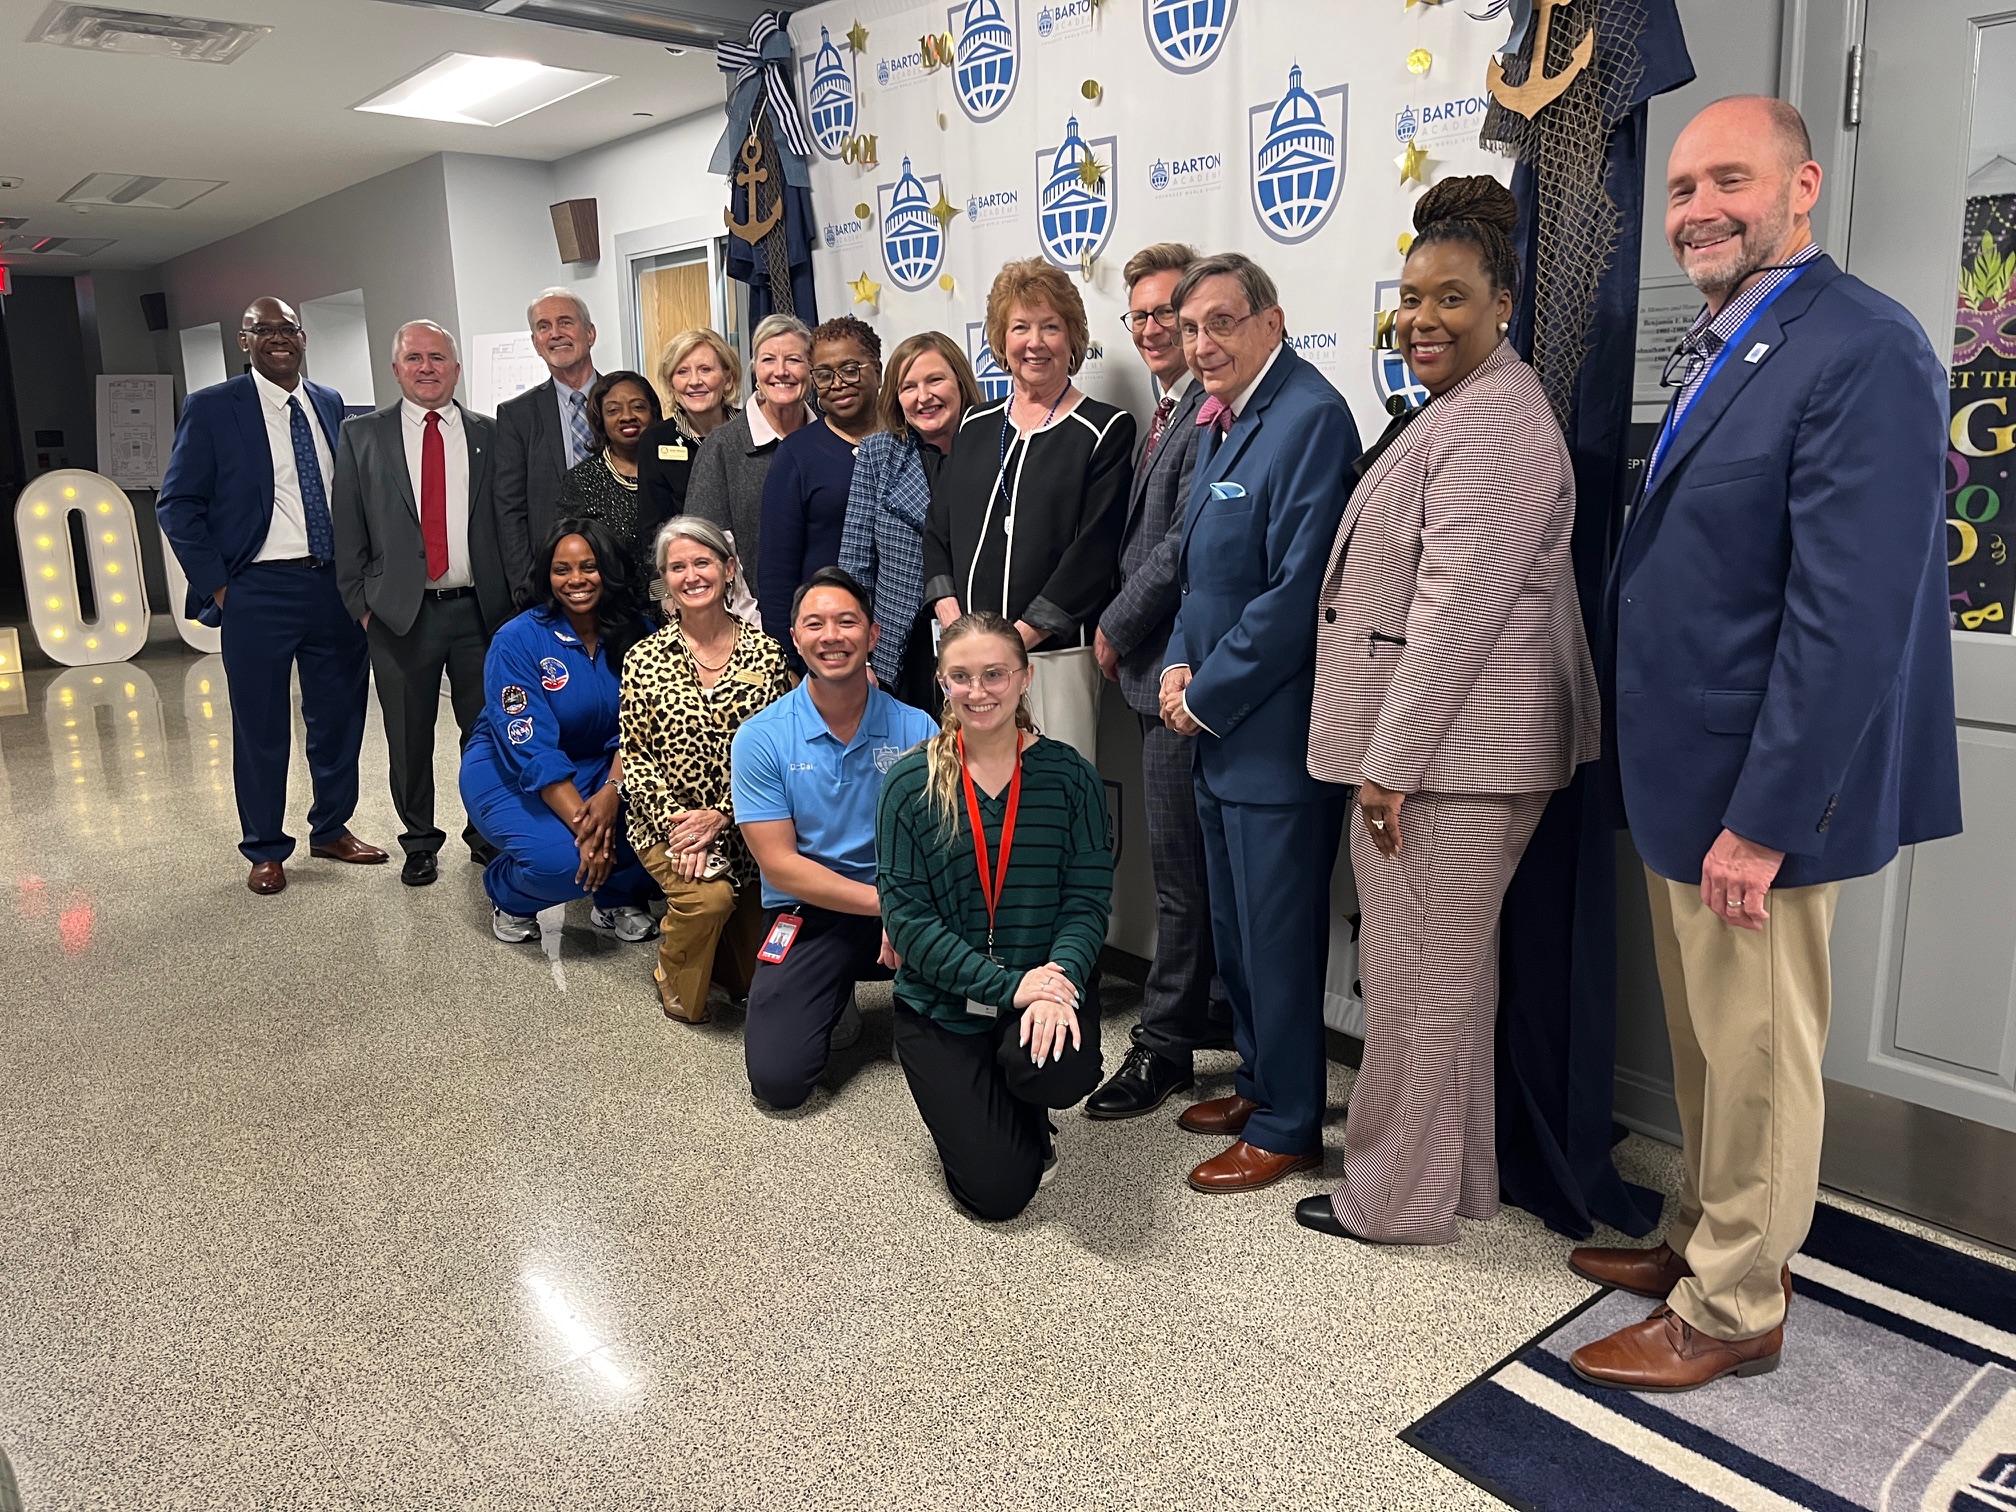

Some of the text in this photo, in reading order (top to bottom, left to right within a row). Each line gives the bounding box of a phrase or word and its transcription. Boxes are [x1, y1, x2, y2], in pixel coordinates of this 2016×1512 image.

[1055, 0, 1092, 21] BARTO
[918, 31, 954, 67] 100
[891, 52, 922, 72] BARTO
[1422, 92, 1490, 123] BARTON
[1421, 117, 1480, 136] ACADEM
[1172, 152, 1221, 175] BARTON
[978, 190, 1018, 209] BARTON
[835, 220, 863, 236] BARTON
[1287, 332, 1336, 350] BARTON
[1302, 350, 1336, 360] ADEMY
[1980, 370, 2016, 389] TH
